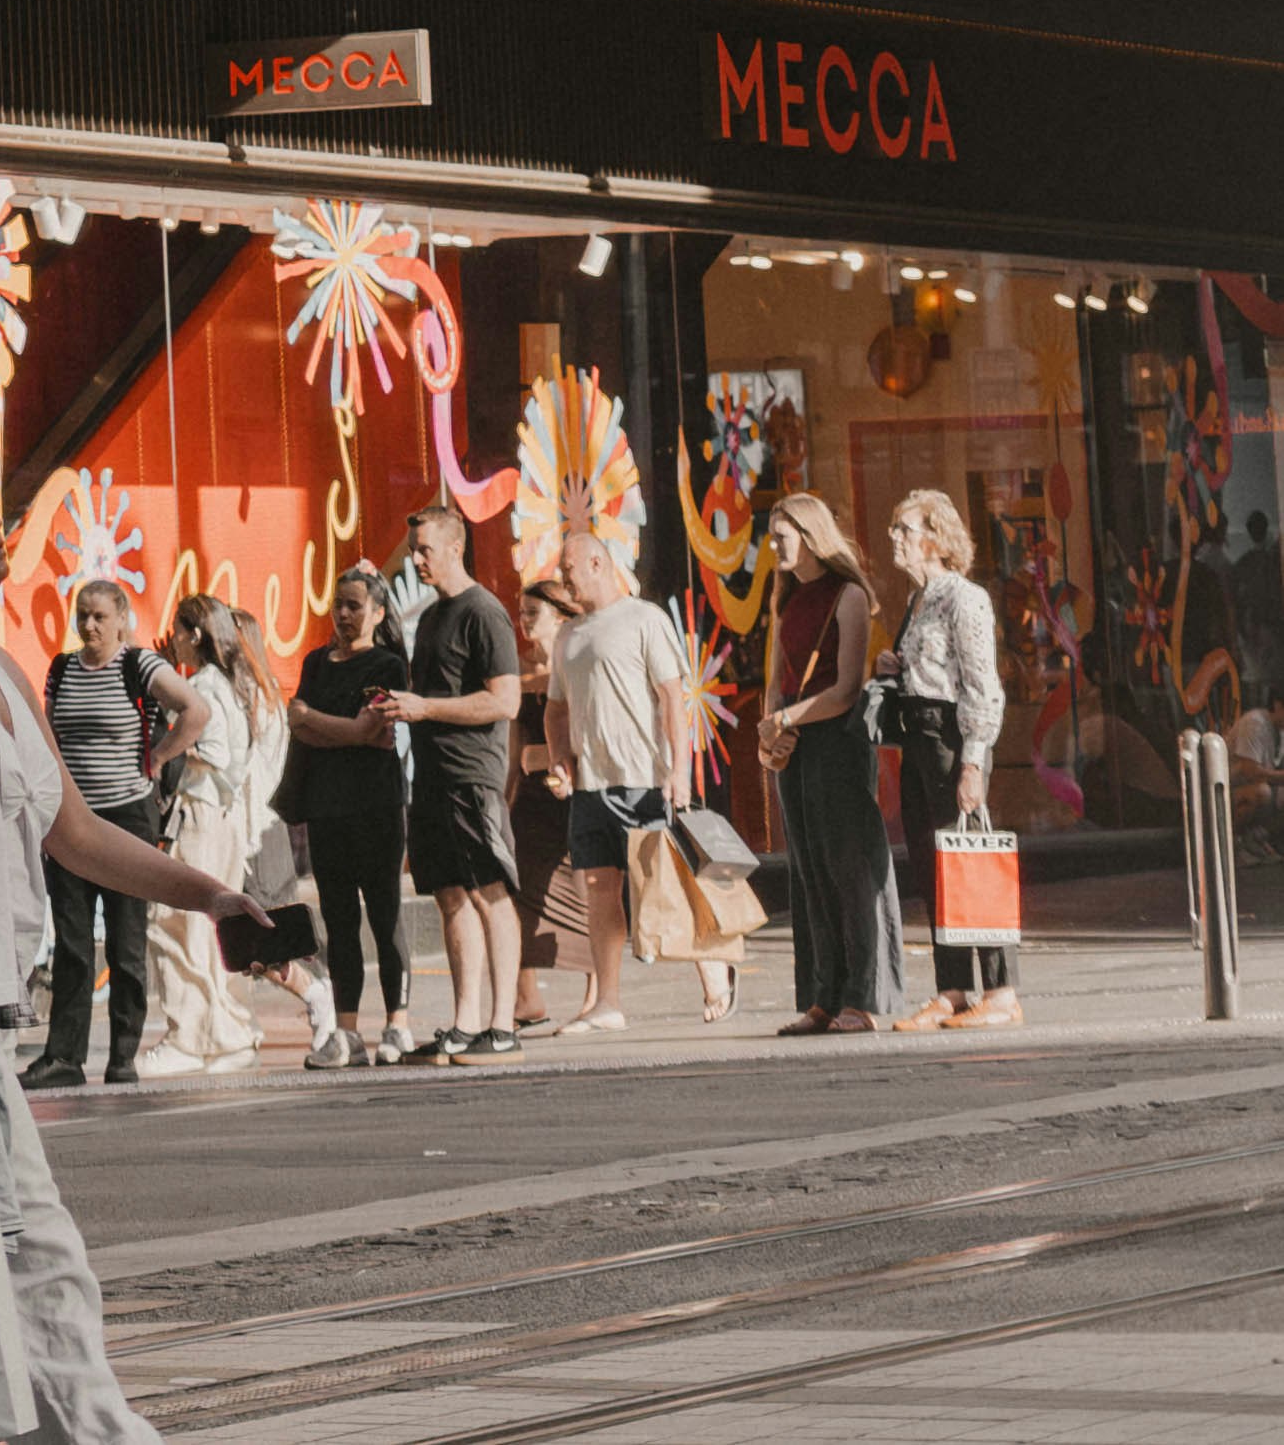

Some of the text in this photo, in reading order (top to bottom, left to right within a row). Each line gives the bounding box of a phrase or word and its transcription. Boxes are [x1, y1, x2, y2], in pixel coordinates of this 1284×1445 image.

[229, 48, 410, 98] MECCA
[716, 32, 957, 161] MECCA
[944, 836, 1013, 848] MYER
